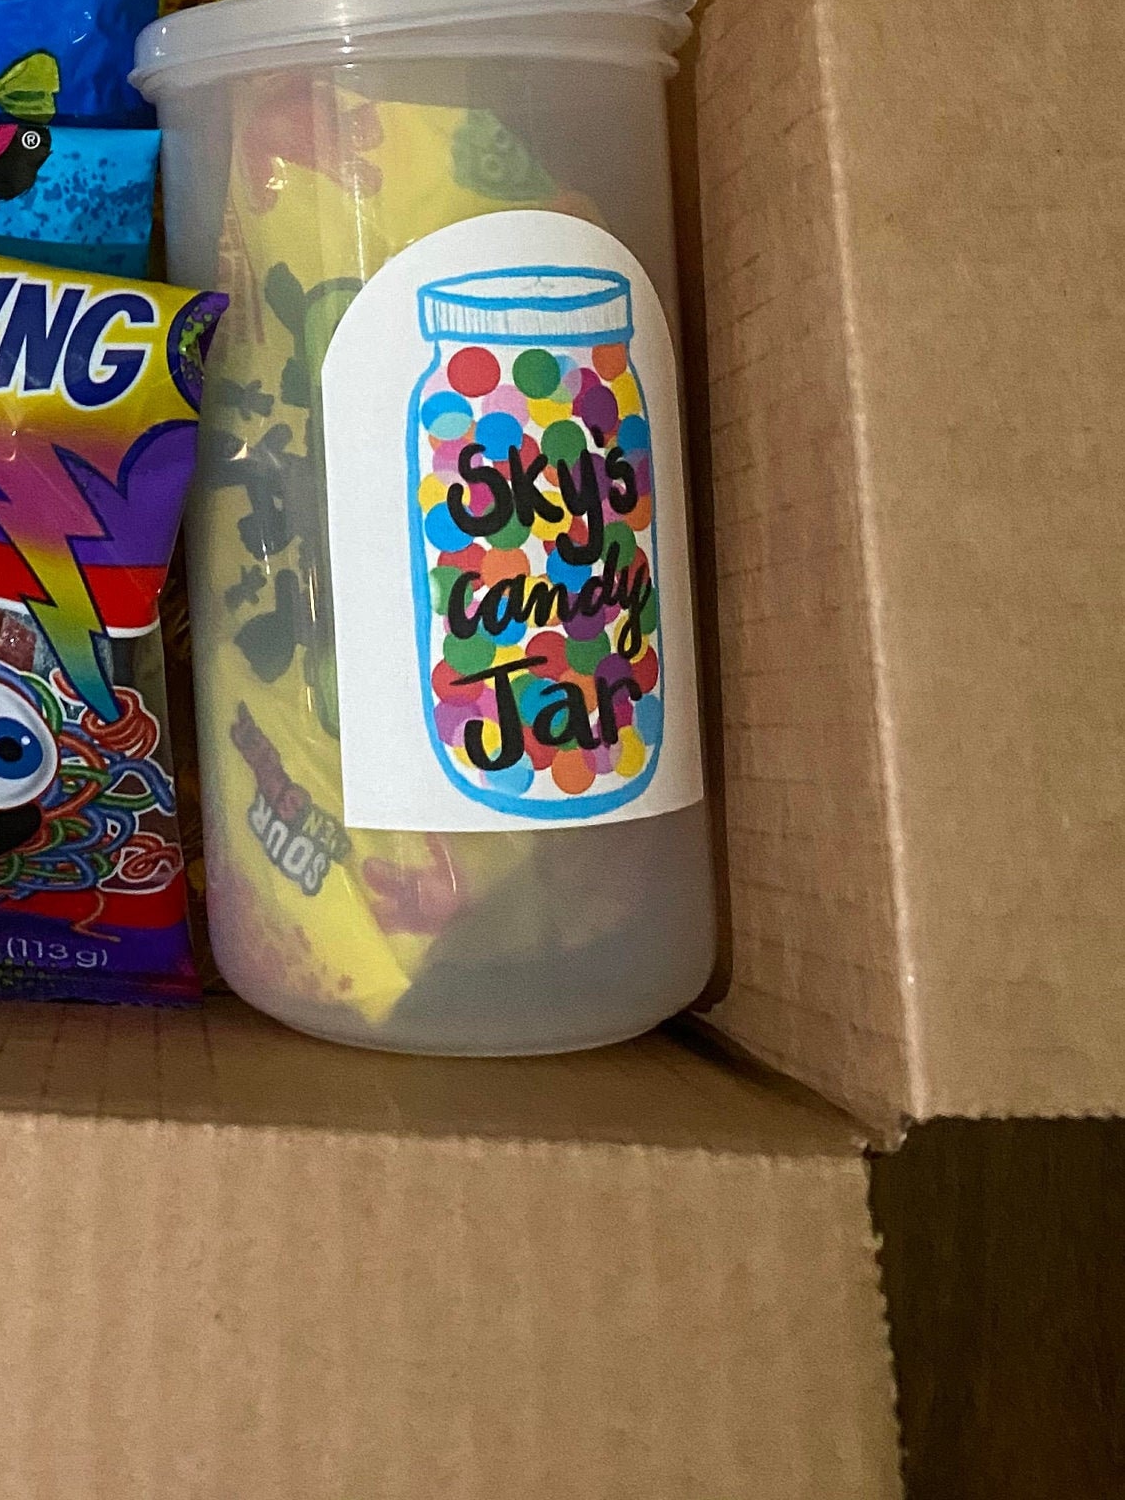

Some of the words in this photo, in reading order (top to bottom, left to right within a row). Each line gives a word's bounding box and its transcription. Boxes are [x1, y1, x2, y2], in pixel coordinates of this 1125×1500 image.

[447, 540, 653, 660] candy
[450, 656, 642, 772] Jar
[250, 794, 327, 891] SOUR
